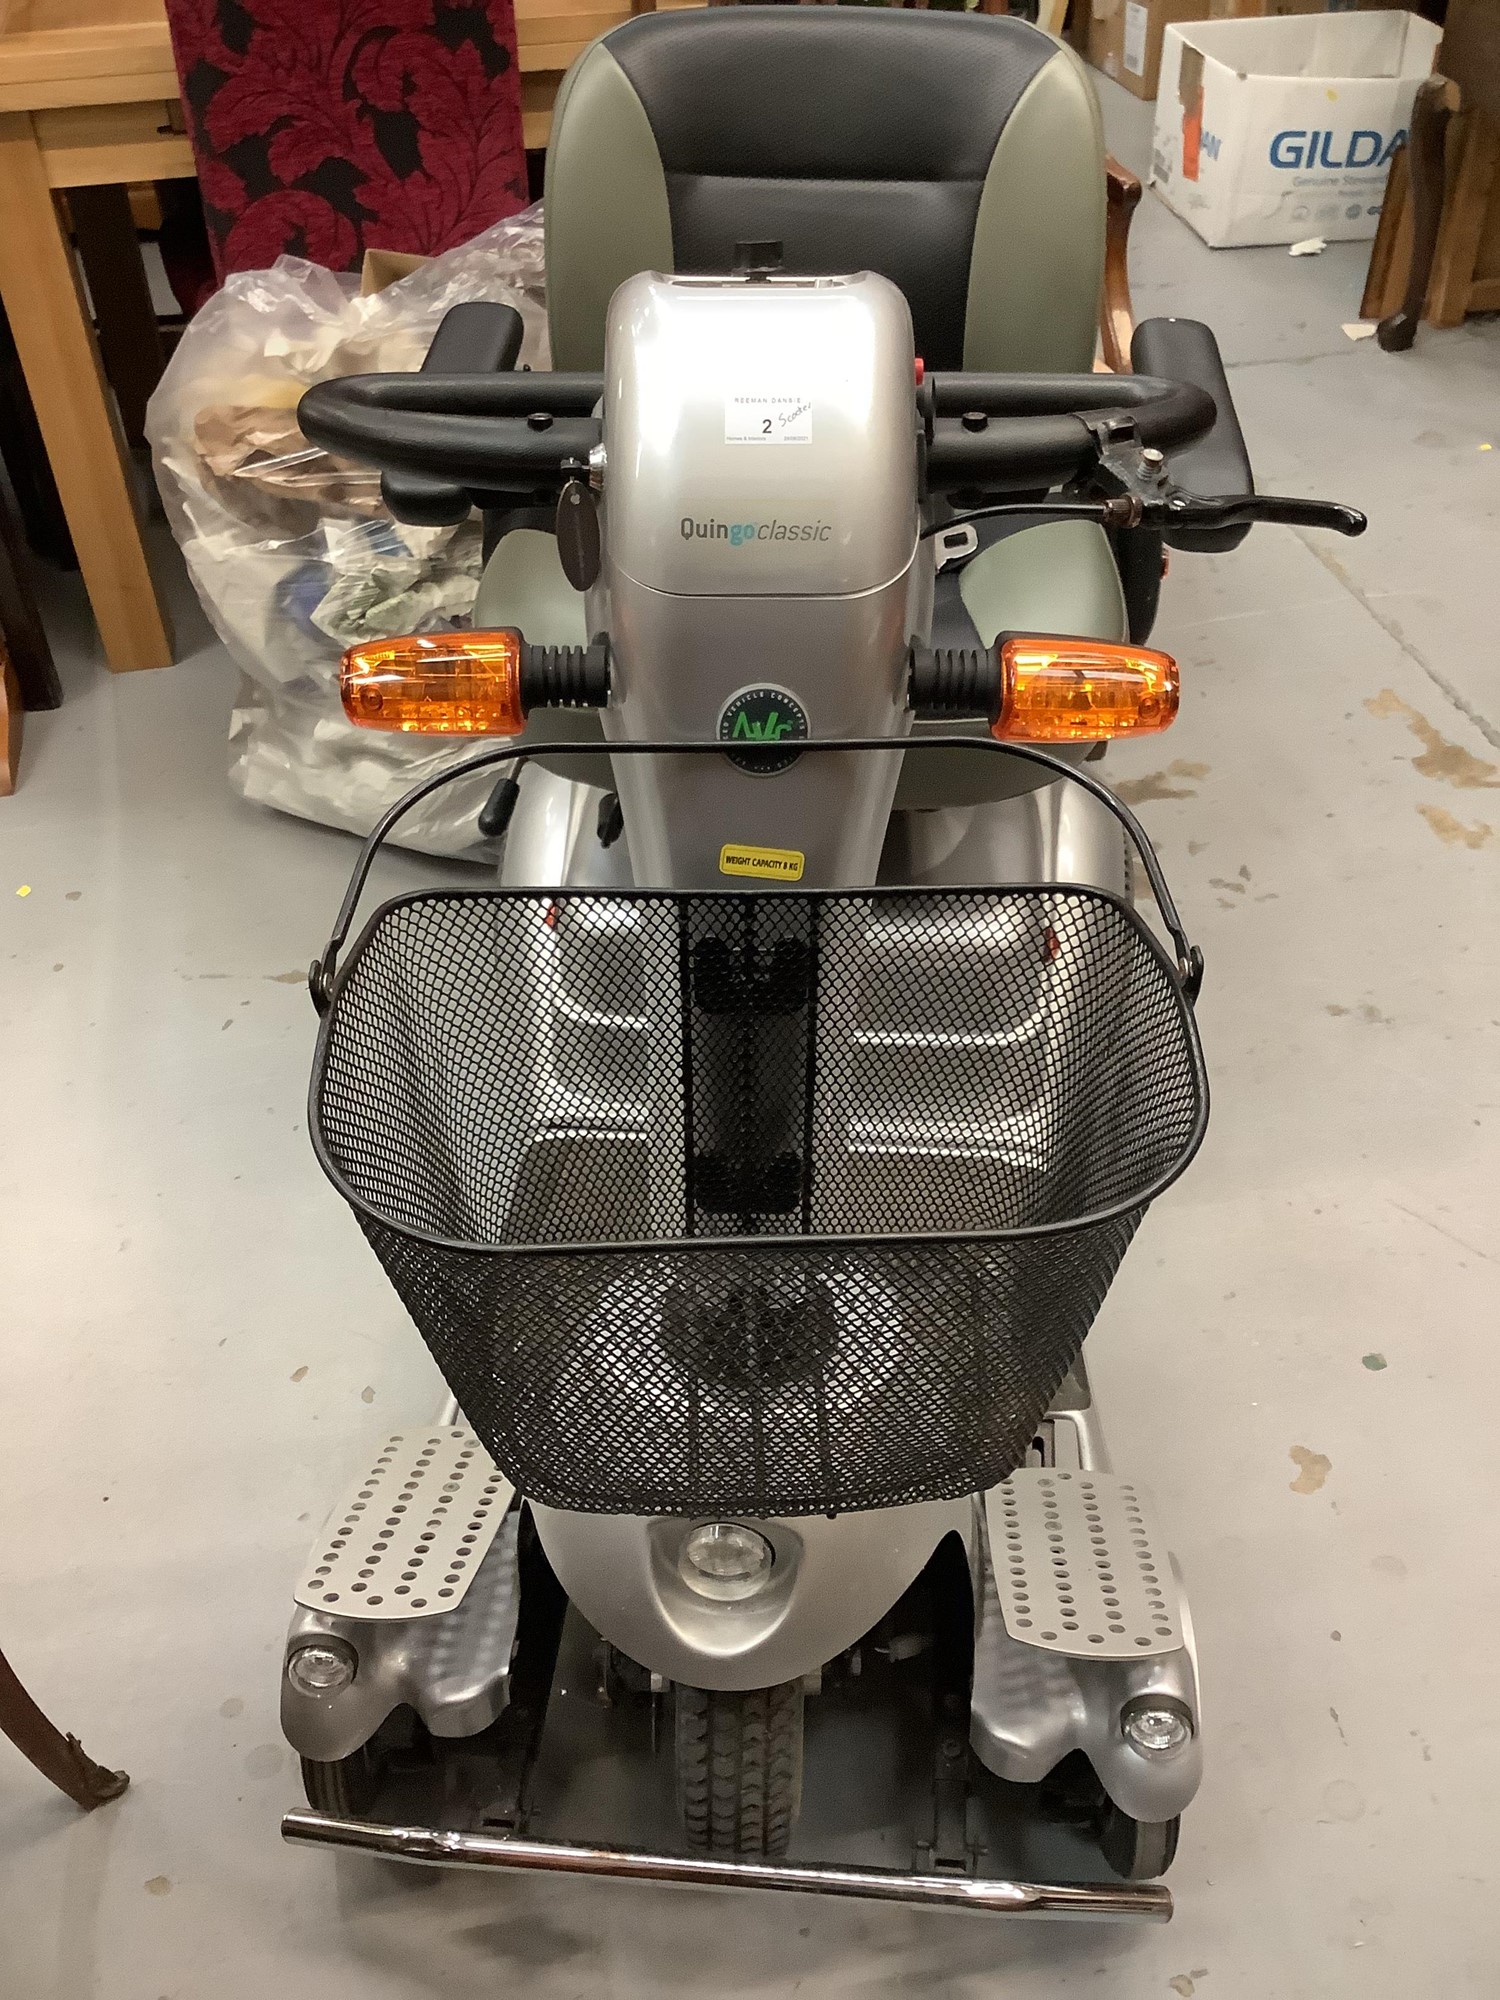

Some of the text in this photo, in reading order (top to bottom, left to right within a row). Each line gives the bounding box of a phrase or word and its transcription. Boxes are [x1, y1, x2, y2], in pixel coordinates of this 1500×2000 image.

[762, 419, 772, 434] 2
[726, 691, 805, 730] VEHICLE CONCEPTS
[726, 855, 799, 872] WEIGHT CAPACITY 8 KG
